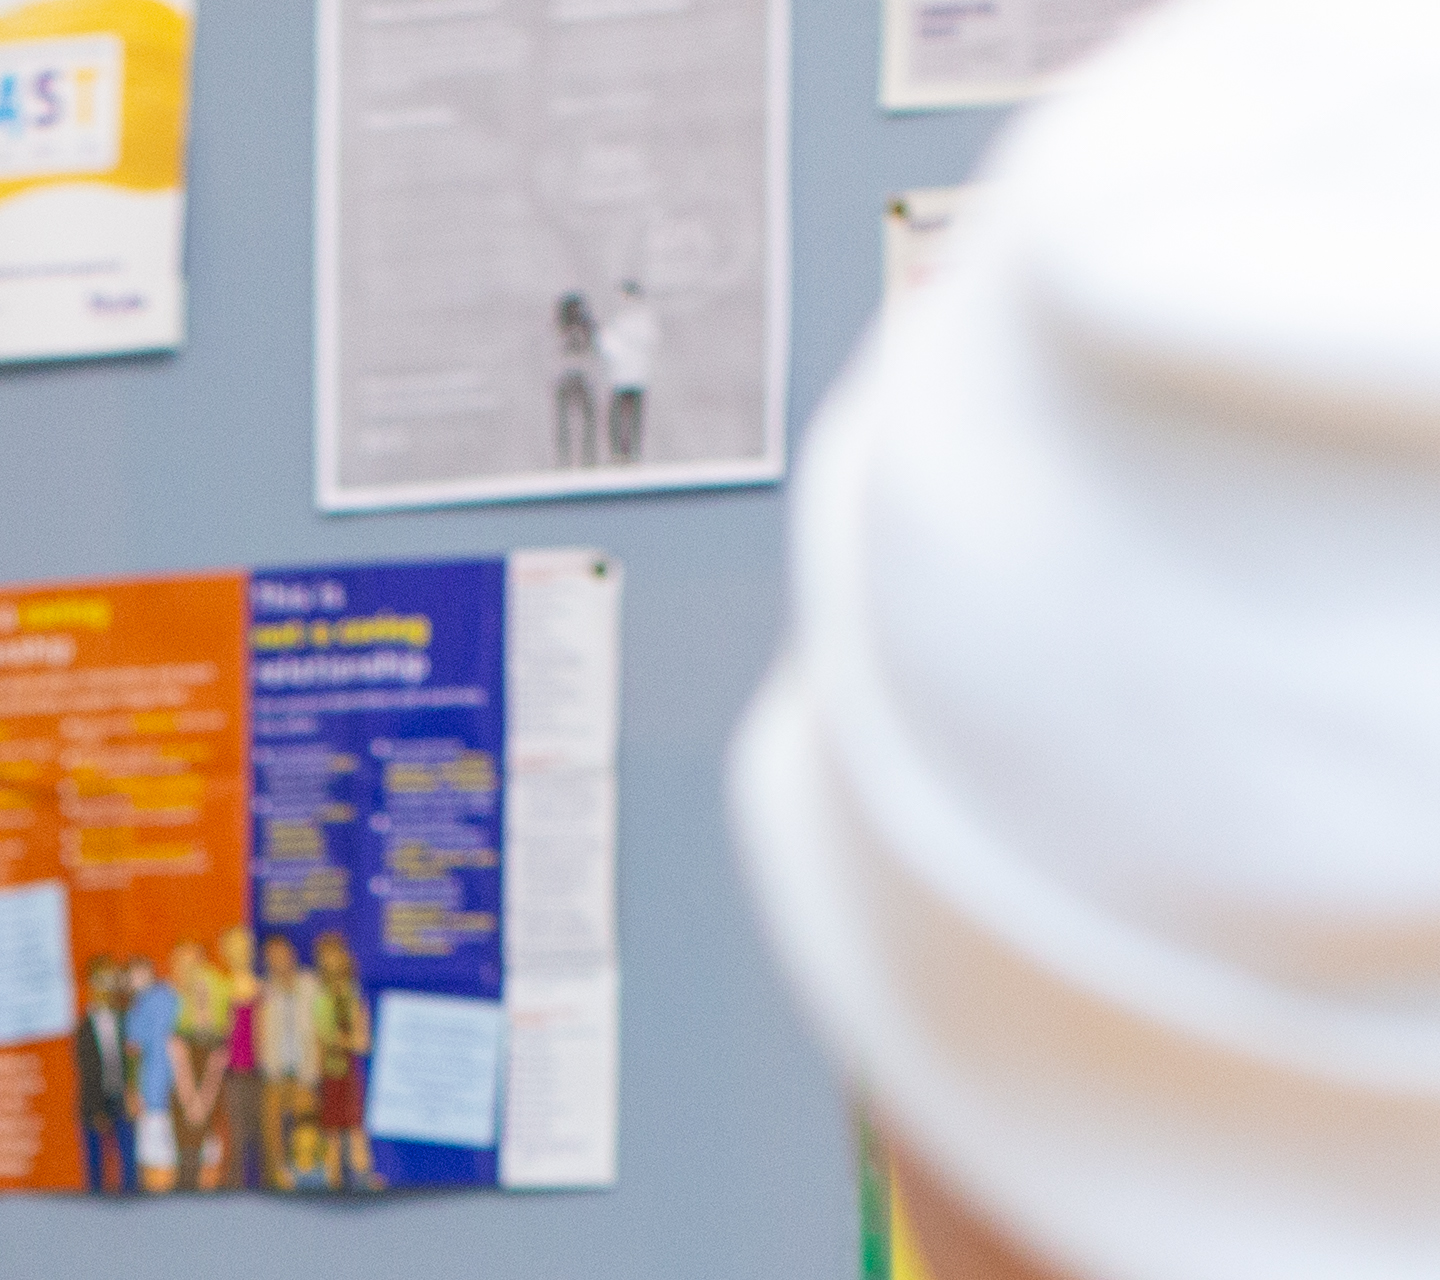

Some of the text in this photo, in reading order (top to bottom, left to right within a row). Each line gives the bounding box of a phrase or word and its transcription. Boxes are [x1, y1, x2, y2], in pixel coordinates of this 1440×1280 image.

[253, 579, 344, 612] This is
[252, 621, 302, 648] not
[253, 651, 429, 688] relationship
